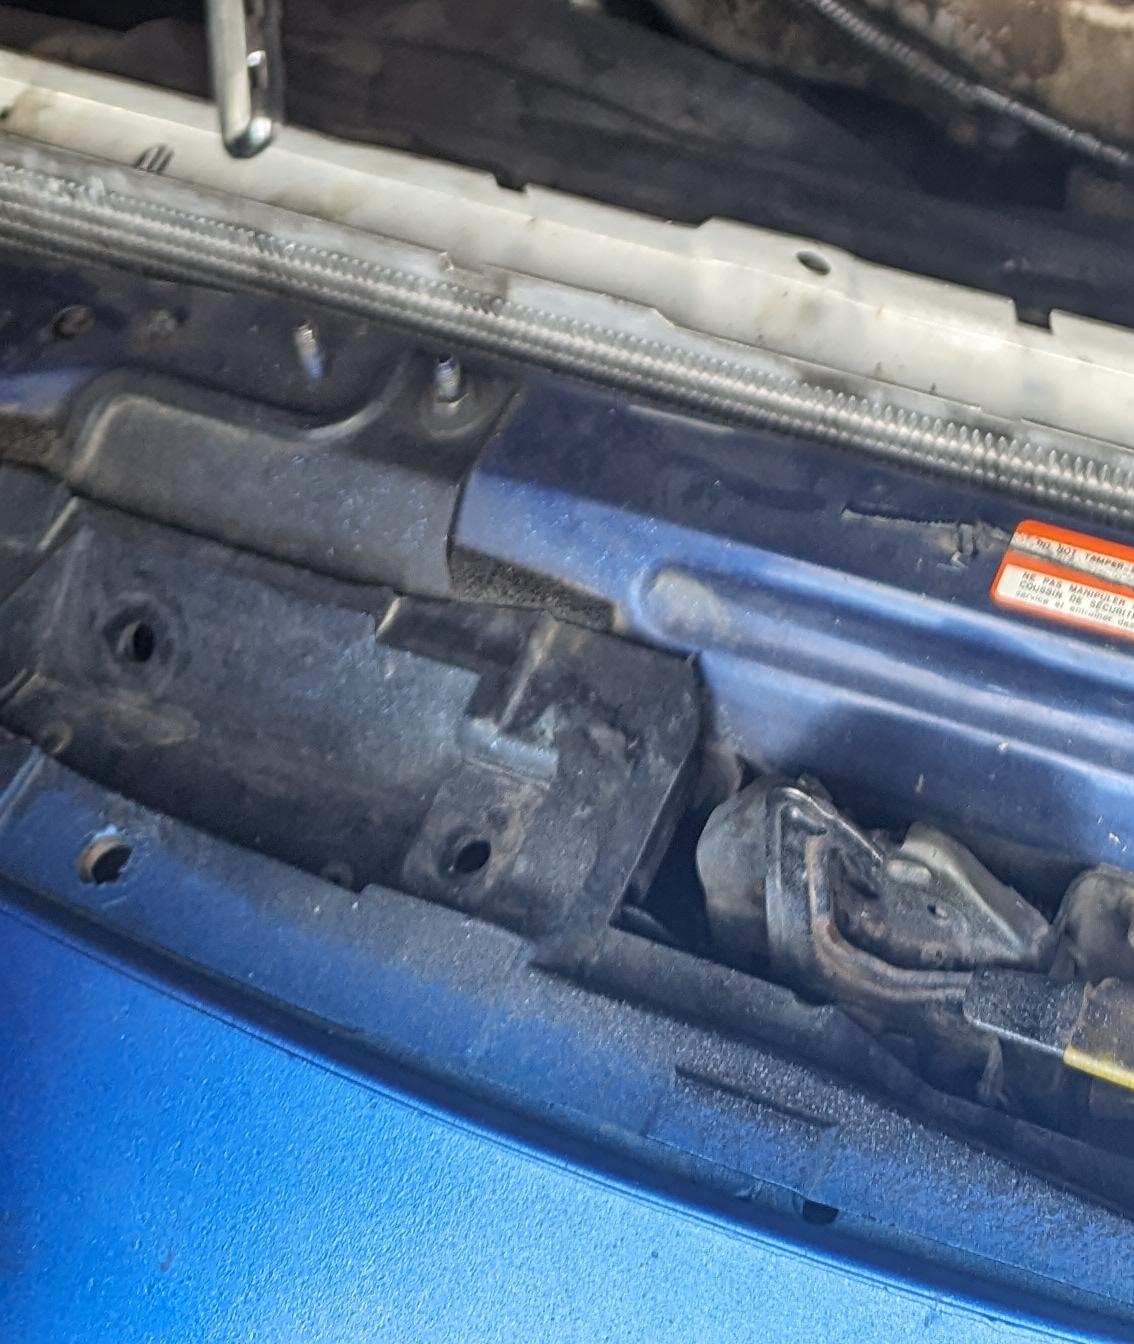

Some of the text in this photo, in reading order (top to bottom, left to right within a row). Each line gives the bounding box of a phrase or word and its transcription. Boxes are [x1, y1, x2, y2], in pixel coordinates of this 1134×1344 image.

[1083, 551, 1125, 570] TAMPER
[1014, 588, 1049, 605] service
[1017, 579, 1063, 599] COUSSIN
[1067, 593, 1083, 604] DE
[1021, 570, 1036, 582] NE
[1041, 576, 1063, 589] PAS
[1067, 583, 1126, 607] MANIPULER
